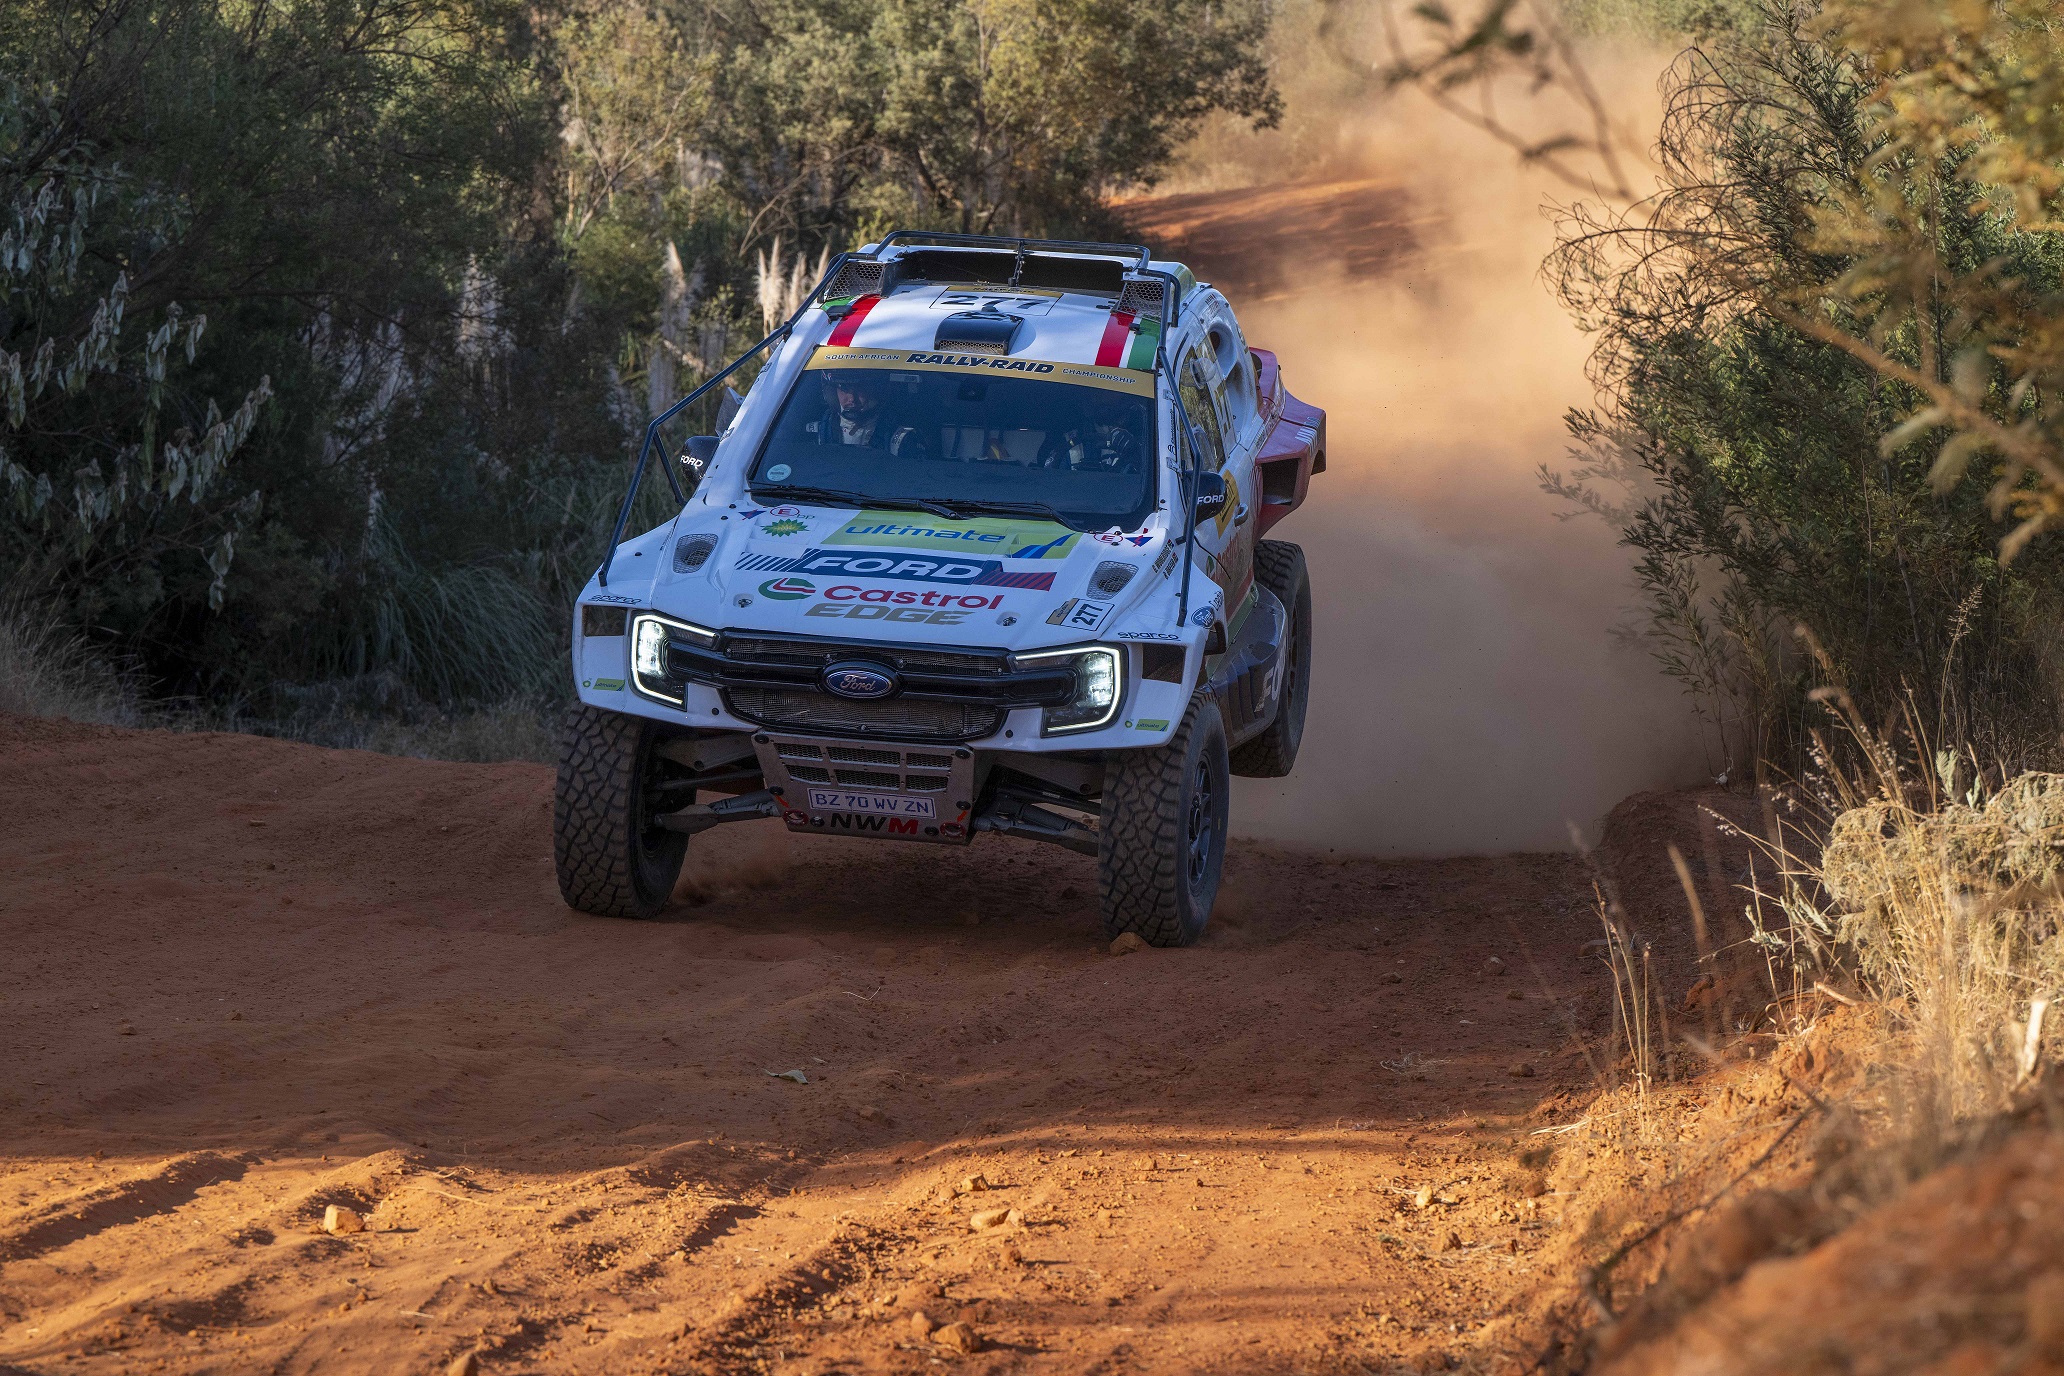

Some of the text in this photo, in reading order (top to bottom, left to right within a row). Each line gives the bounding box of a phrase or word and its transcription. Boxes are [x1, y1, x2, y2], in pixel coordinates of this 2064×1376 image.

[941, 295, 1049, 310] 277
[824, 352, 1136, 385] SOUTH AFRICAN RALLY-RAID CHAMPIONSHIP
[1197, 494, 1225, 504] FORD
[845, 523, 1007, 544] ultimate
[802, 556, 983, 580] FORD
[823, 583, 1004, 610] Castrol
[804, 603, 975, 625] EDGE
[1071, 603, 1103, 626] 277
[1117, 631, 1181, 642] sparco
[840, 674, 876, 691] Ford
[815, 793, 929, 814] BZ 70 WV ZN
[830, 812, 920, 835] NWM
